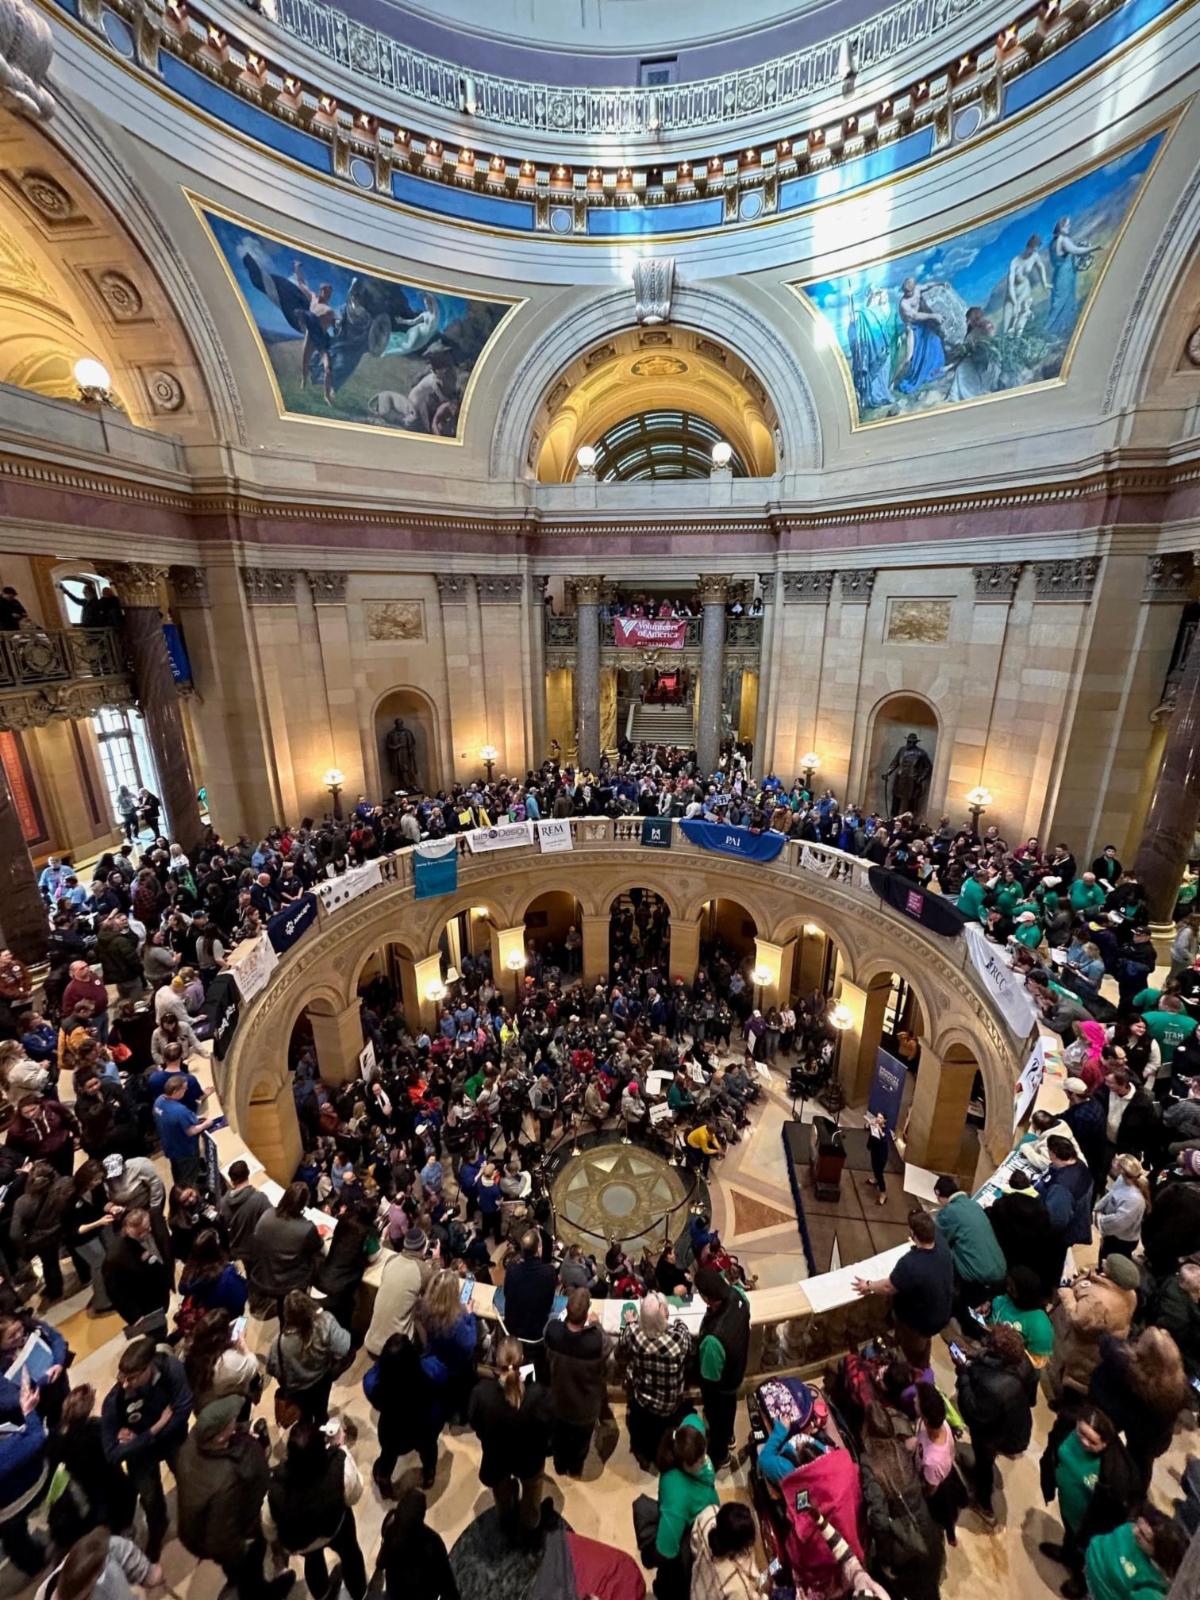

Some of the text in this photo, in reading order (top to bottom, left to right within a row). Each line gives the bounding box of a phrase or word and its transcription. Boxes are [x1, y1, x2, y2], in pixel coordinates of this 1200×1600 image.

[638, 622, 678, 631] Volunteers
[637, 629, 678, 639] of America
[541, 824, 564, 837] REM
[725, 835, 741, 847] PAI
[990, 965, 1007, 991] RCC
